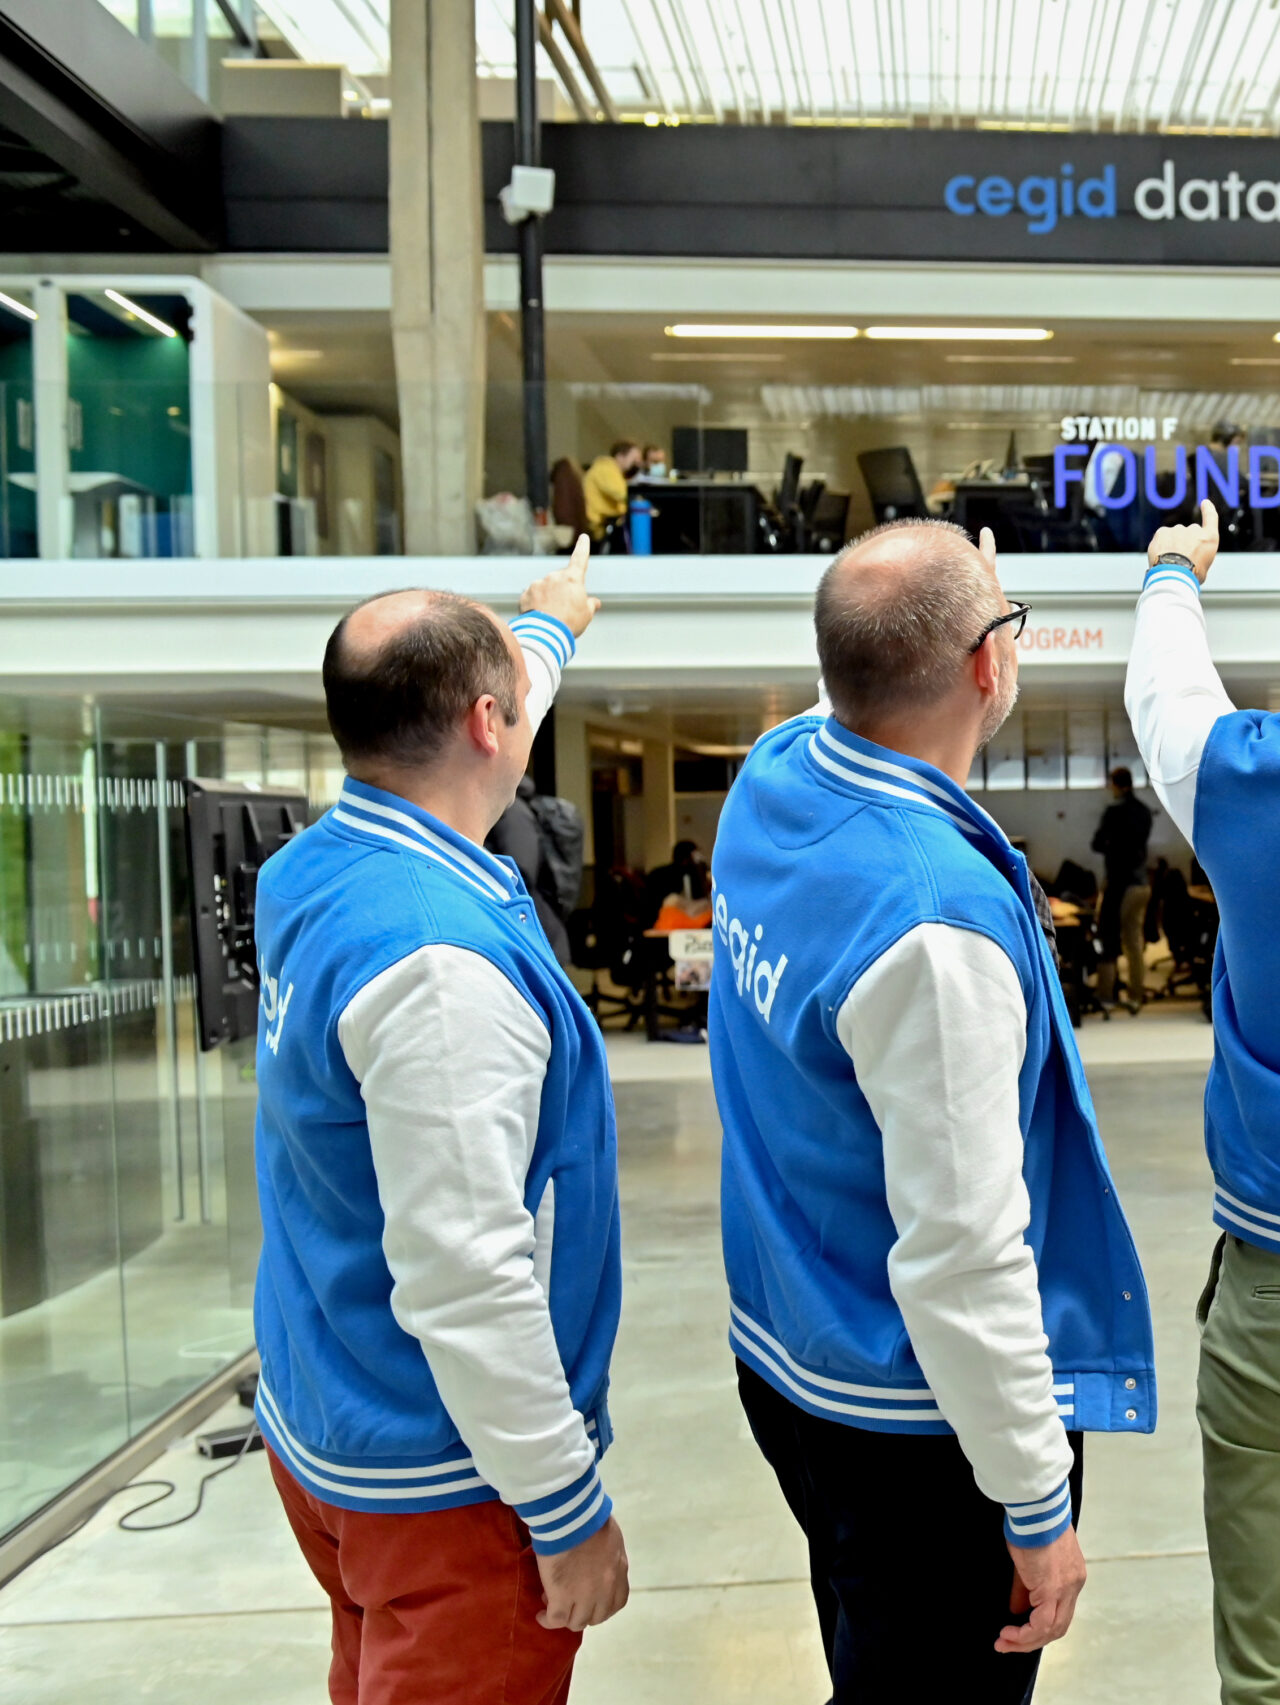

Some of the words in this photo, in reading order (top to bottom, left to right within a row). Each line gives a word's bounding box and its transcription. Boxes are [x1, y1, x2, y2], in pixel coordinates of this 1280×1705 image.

[944, 162, 1117, 234] cegid
[1060, 416, 1156, 441] STATION
[1162, 417, 1178, 440] F
[1018, 627, 1104, 651] OGRAM
[711, 875, 788, 1024] egid
